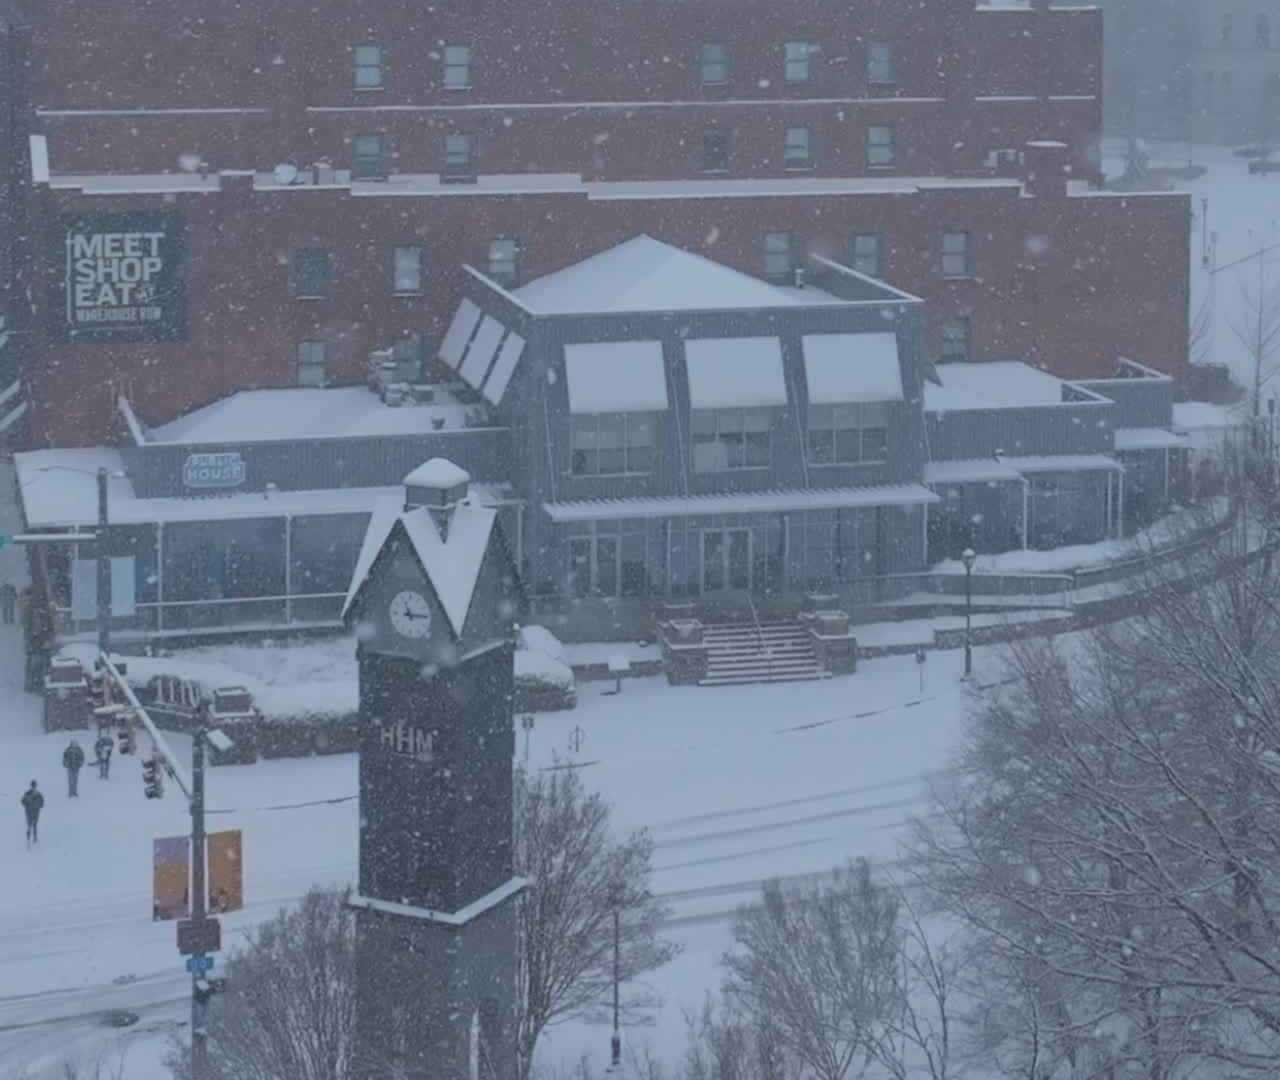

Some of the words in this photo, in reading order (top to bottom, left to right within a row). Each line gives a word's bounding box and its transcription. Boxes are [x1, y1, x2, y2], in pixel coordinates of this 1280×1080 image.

[73, 232, 166, 258] MEET
[74, 257, 163, 283] SHOP
[74, 282, 137, 307] EAT
[76, 306, 138, 322] WAREHOUSE
[140, 305, 163, 322] ROW
[186, 466, 241, 481] HOUSE
